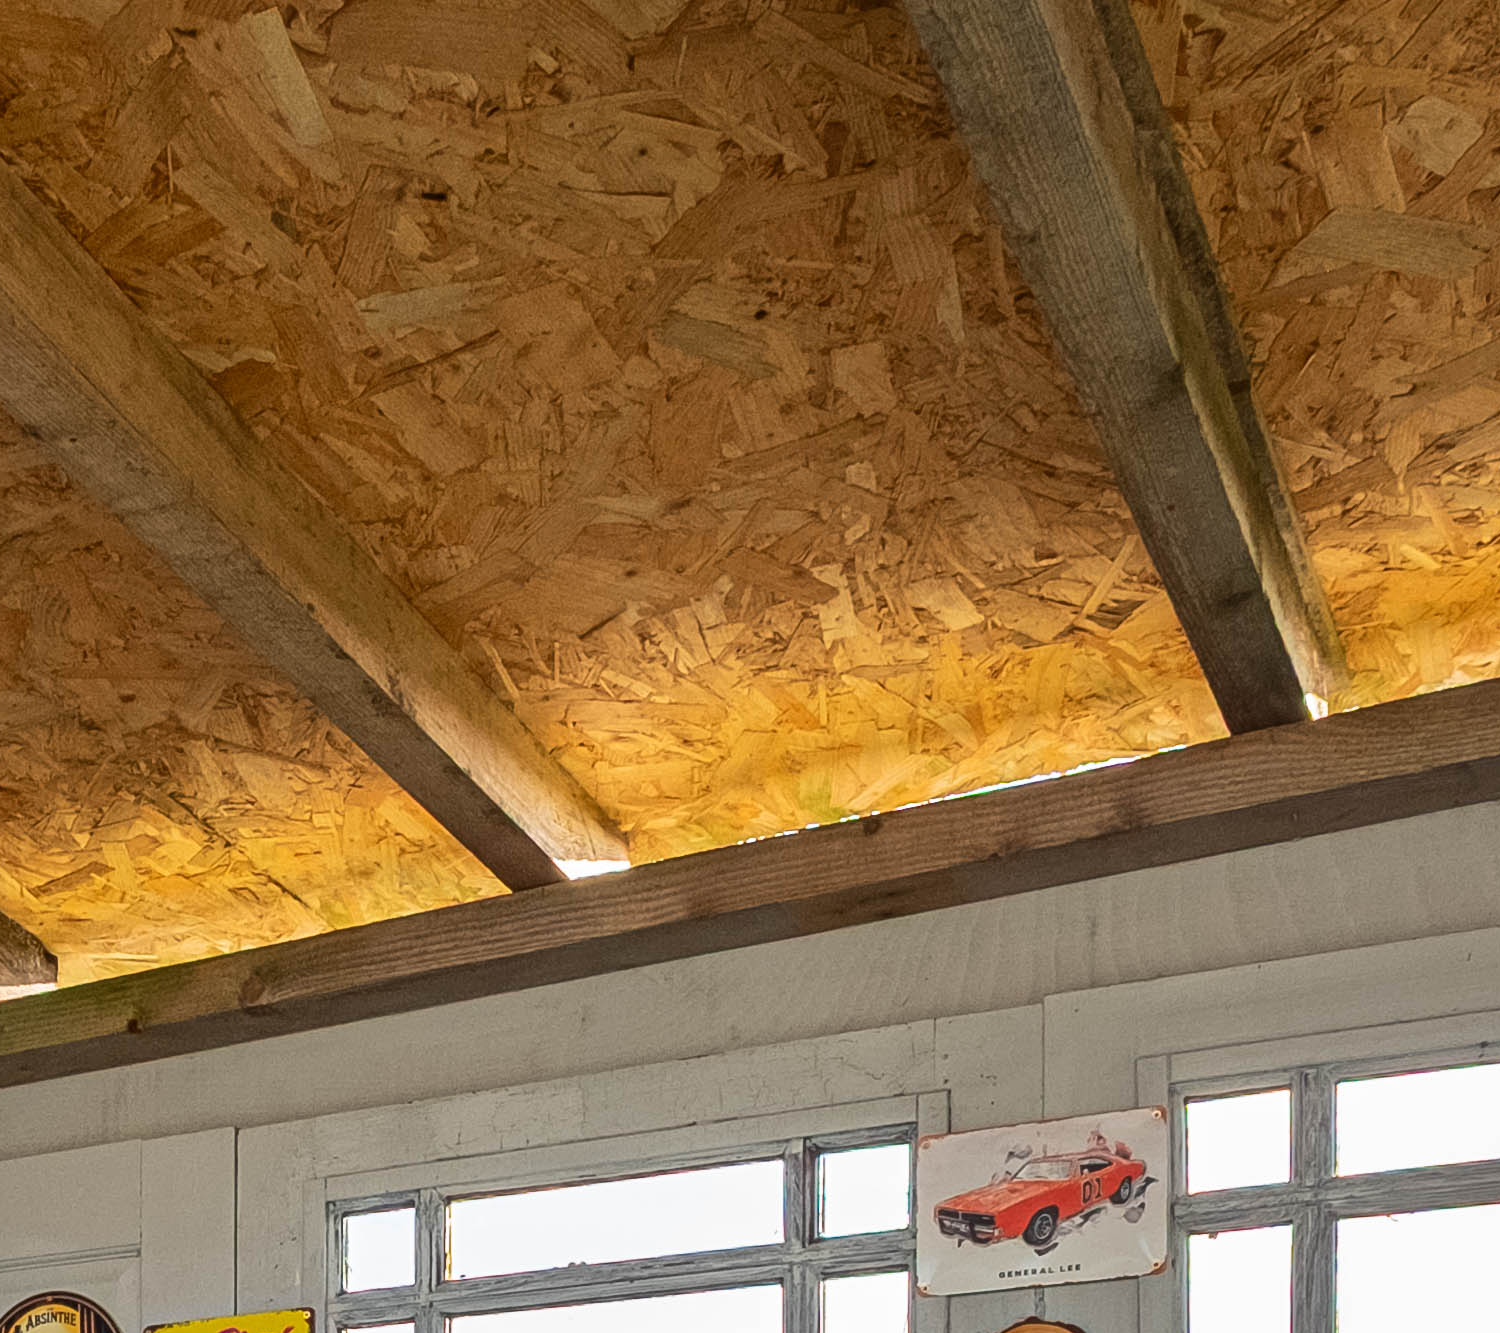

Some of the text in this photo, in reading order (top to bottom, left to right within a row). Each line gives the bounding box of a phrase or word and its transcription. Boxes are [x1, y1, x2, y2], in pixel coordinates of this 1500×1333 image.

[998, 1264, 1081, 1279] GENERAL LEE
[26, 1311, 77, 1331] ABSINTHE
